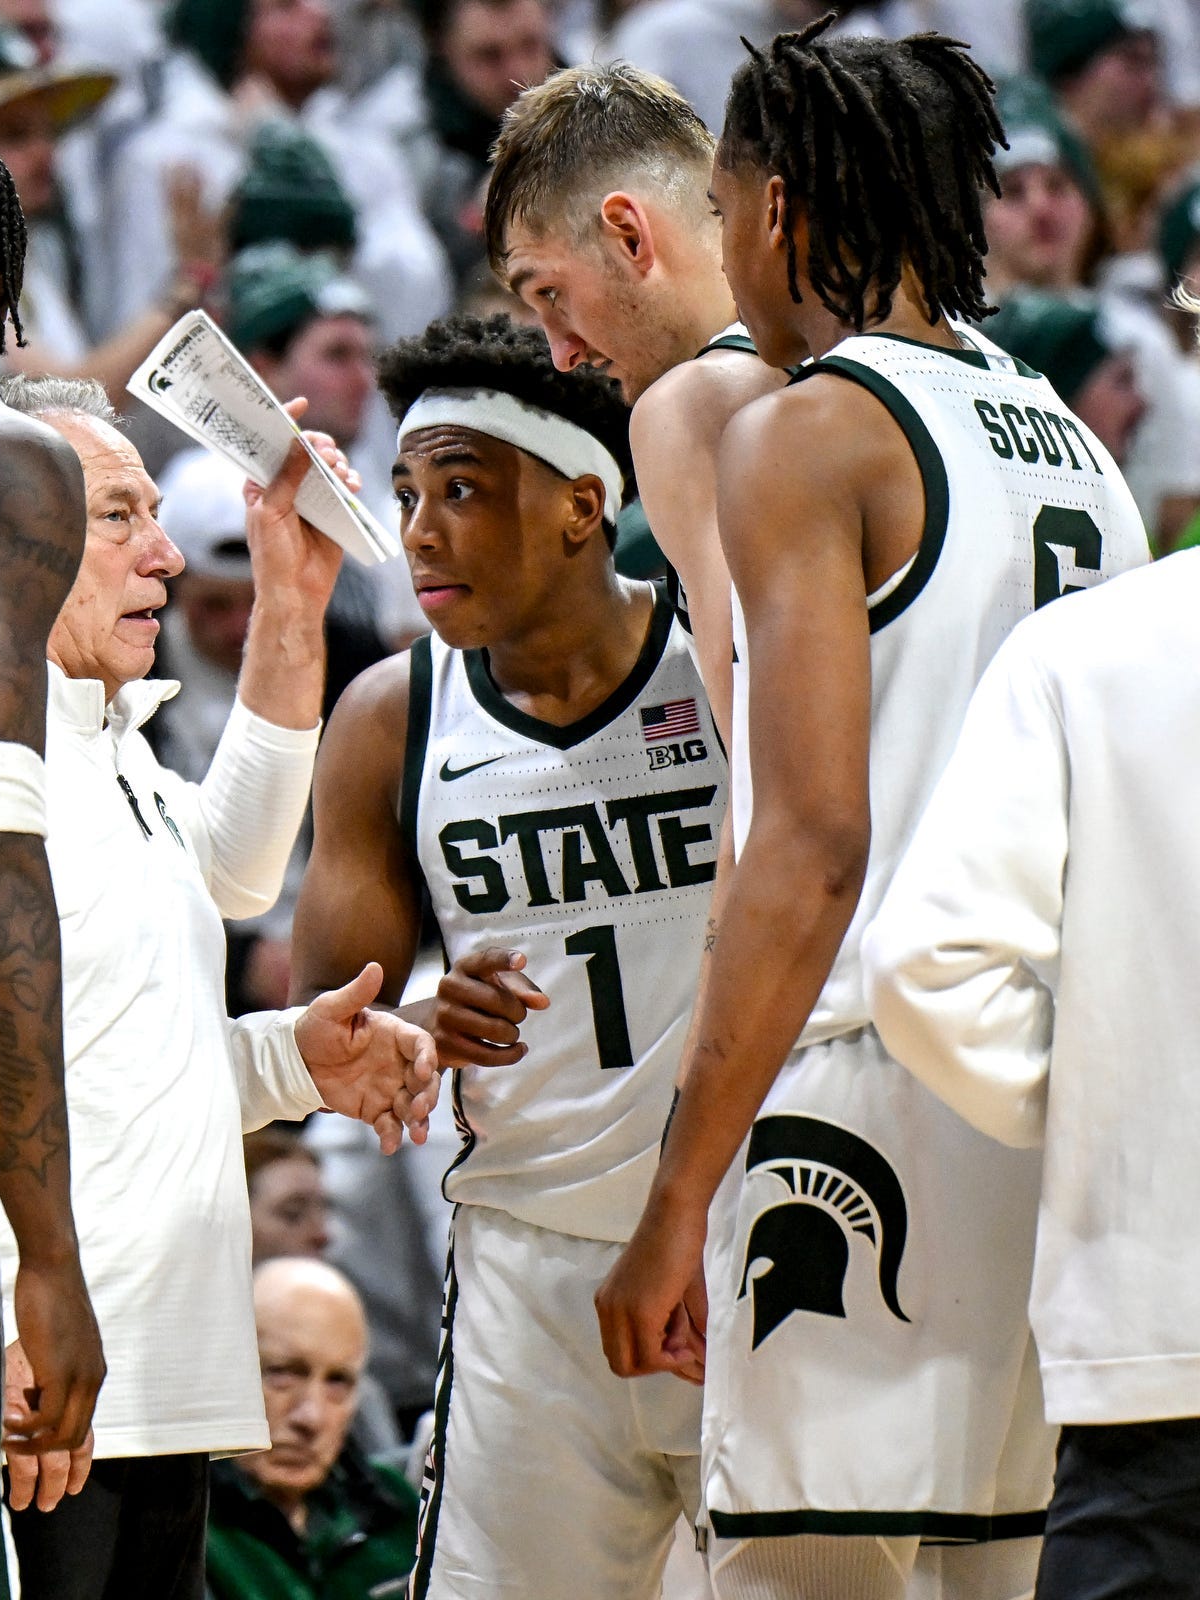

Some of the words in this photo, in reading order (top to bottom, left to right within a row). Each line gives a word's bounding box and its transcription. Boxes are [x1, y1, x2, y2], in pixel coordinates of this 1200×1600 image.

[974, 399, 1104, 476] SCOTT
[438, 784, 718, 915] STATE
[564, 924, 634, 1070] 1
